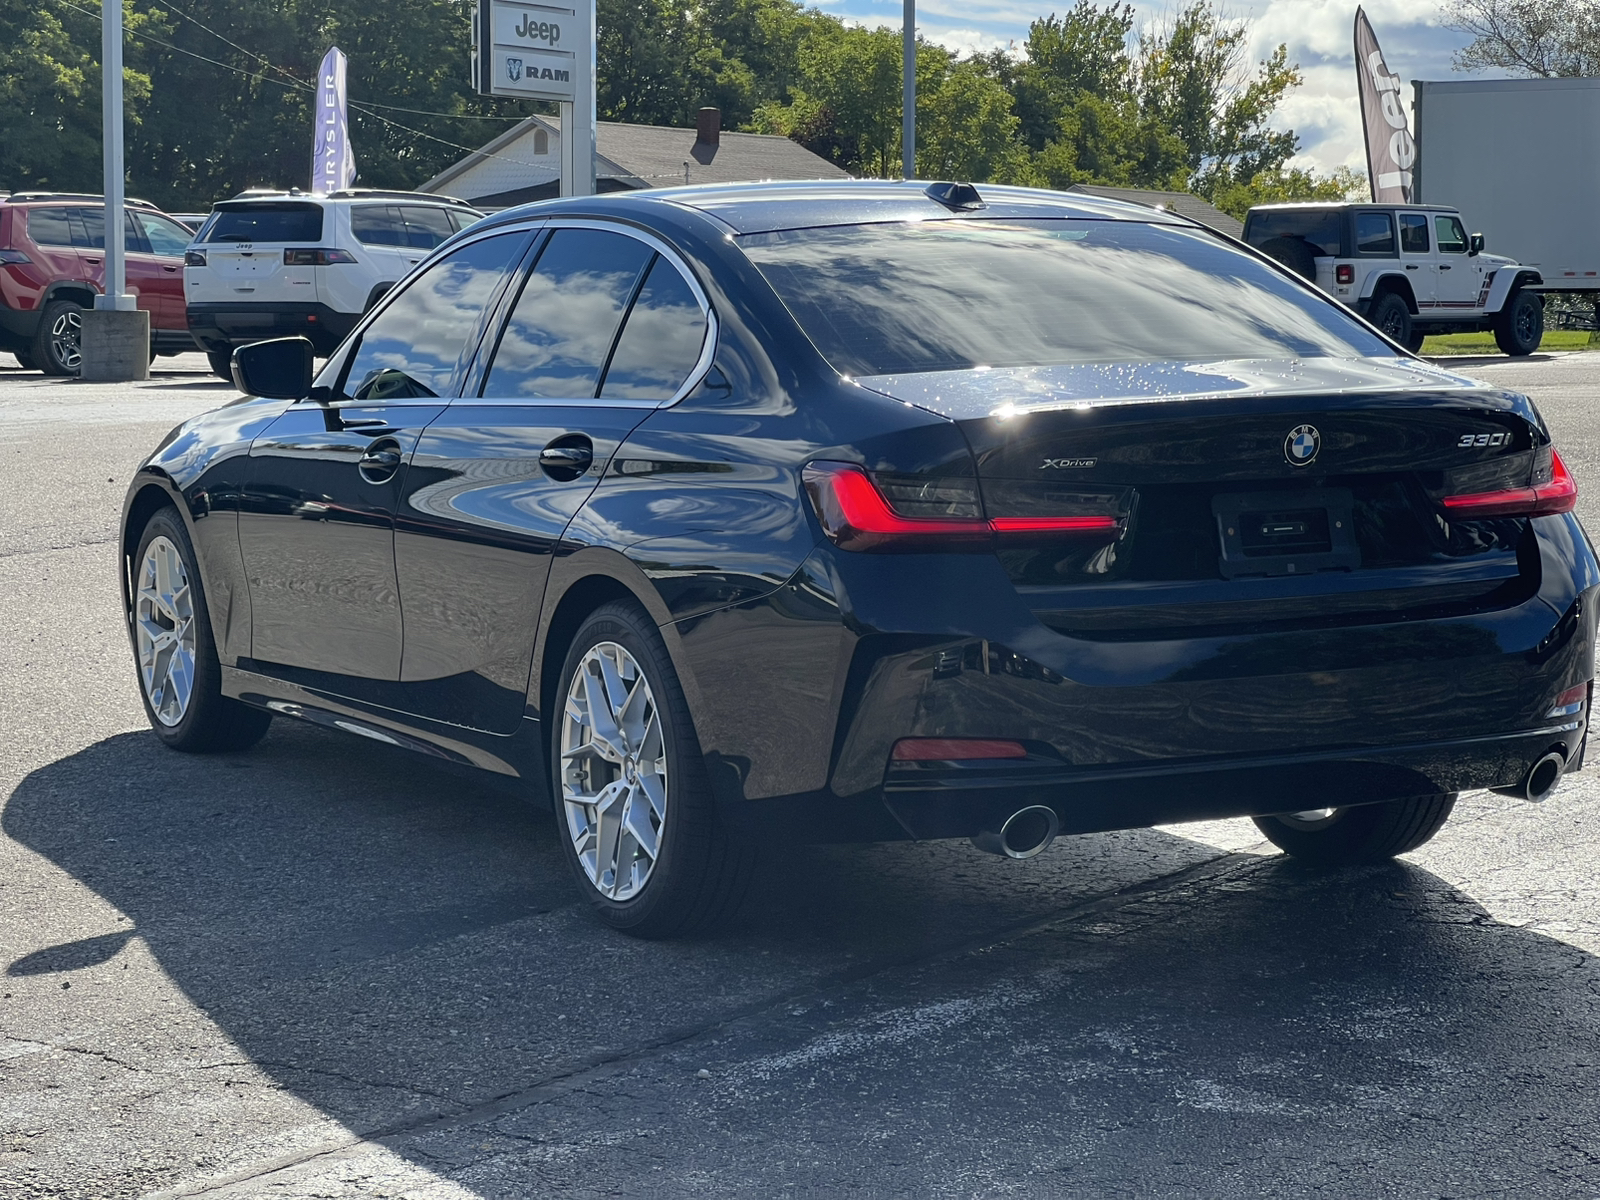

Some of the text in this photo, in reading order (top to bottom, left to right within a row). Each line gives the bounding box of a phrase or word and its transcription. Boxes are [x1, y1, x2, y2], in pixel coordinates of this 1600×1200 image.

[515, 13, 560, 46] Jeep
[525, 66, 570, 82] RAM
[325, 74, 336, 194] HRYSLER
[1367, 50, 1417, 204] Jeep
[1457, 432, 1511, 448] 330i
